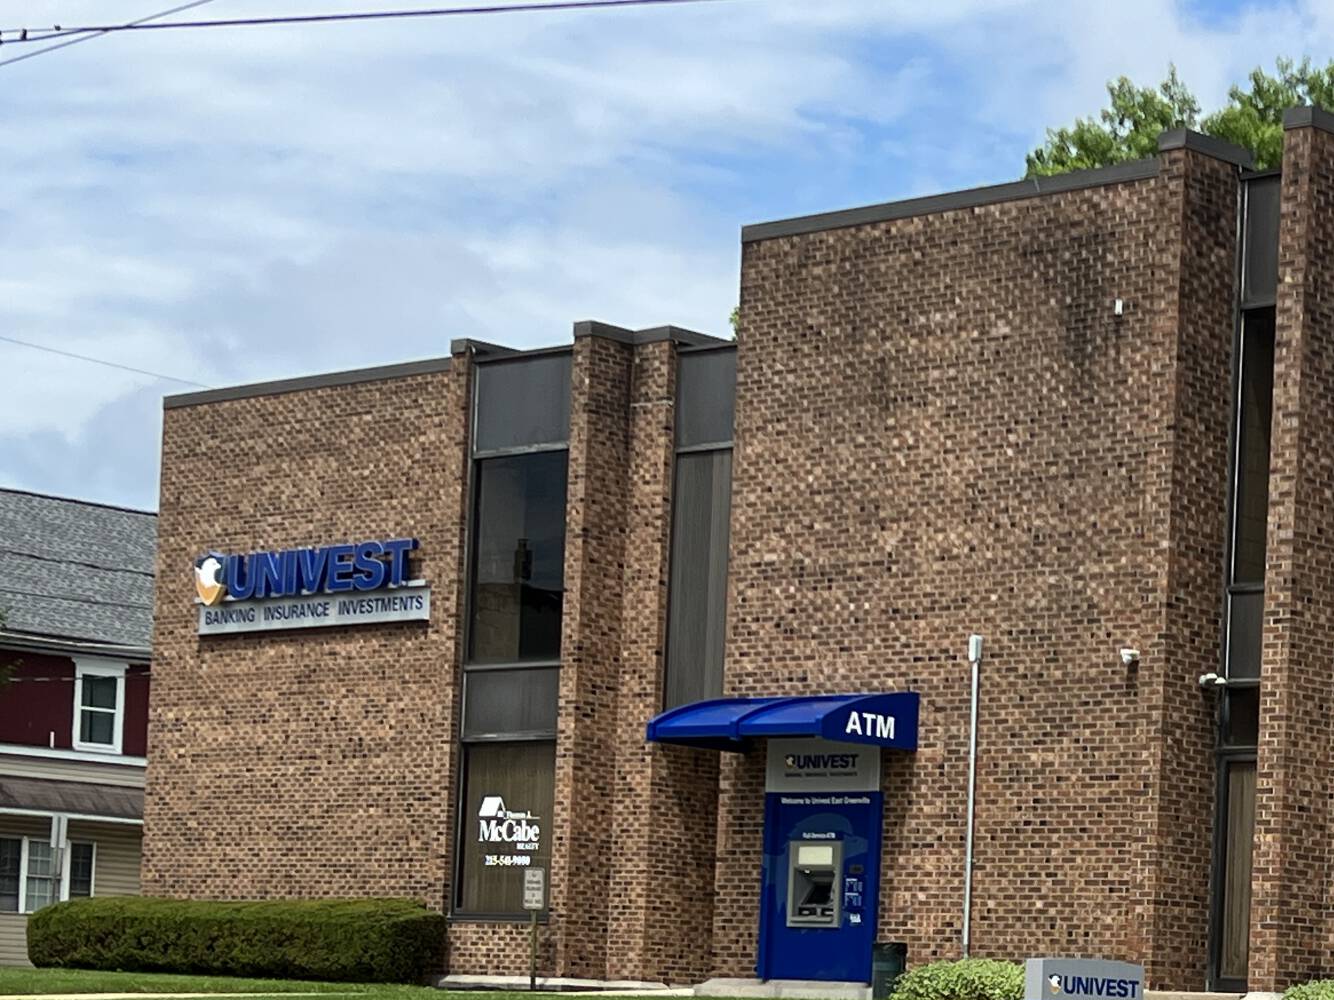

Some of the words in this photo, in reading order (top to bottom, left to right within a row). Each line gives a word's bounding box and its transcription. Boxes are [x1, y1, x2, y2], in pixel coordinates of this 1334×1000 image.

[226, 537, 417, 600] UNIVEST
[205, 608, 256, 626] BANKING
[263, 602, 331, 622] INSURANCE
[337, 595, 424, 616] INVESTMENTS
[845, 711, 896, 740] ATM
[796, 754, 859, 769] UNIVEST
[478, 819, 540, 842] McCabe
[1063, 975, 1140, 998] UNIVEST
